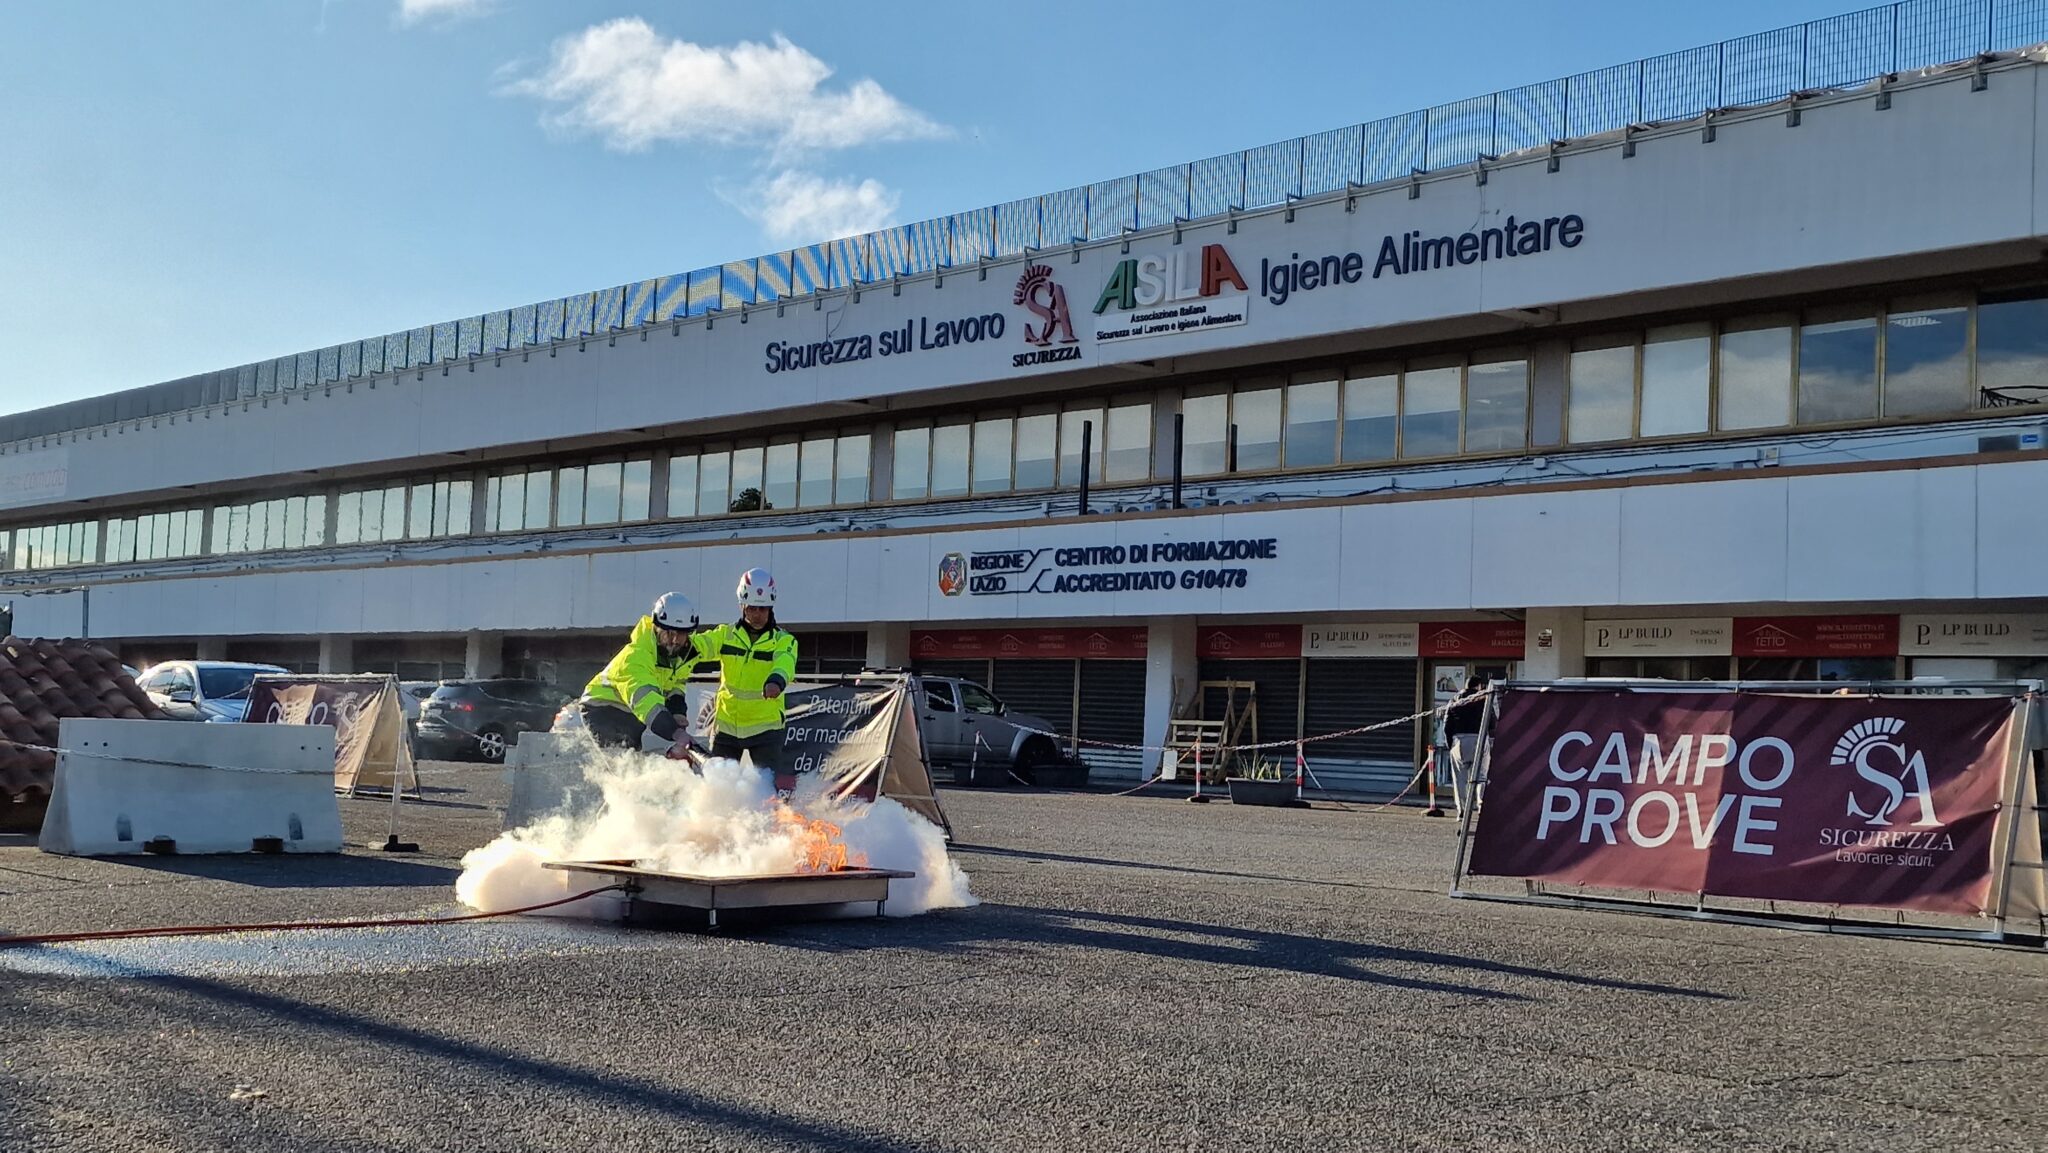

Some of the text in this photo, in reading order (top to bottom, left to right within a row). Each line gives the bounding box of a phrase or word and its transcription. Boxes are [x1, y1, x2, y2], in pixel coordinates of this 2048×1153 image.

[1261, 213, 1584, 305] Igiene Alimentare
[1130, 304, 1207, 323] Associazione Italiana
[1096, 328, 1130, 341] Sicurezza
[1131, 325, 1143, 336] sul
[1144, 321, 1170, 334] Lavoro
[1177, 317, 1200, 331] Igiene
[1201, 312, 1242, 326] Alimentare
[765, 311, 1005, 374] Sicurezza sul Lavoro
[1012, 345, 1081, 367] SICUREZZA
[970, 552, 1025, 571] REGIONE
[1054, 538, 1277, 567] CENTRO DI FORMAZIONE
[970, 573, 1007, 591] LAZIO
[1053, 568, 1248, 594] ACCREDITATO G10478
[1340, 630, 1369, 642] BUILD
[1618, 627, 1673, 640] LP BUILD
[1941, 624, 1960, 636] LP
[809, 694, 872, 715] Patentini
[784, 726, 813, 746] per
[794, 752, 813, 772] da
[1549, 731, 1796, 791] CAMPO
[1536, 786, 1782, 857] PROVE
[1819, 827, 1955, 852] SICUREZZA
[1835, 850, 1935, 868] Lavorare sicuri.
